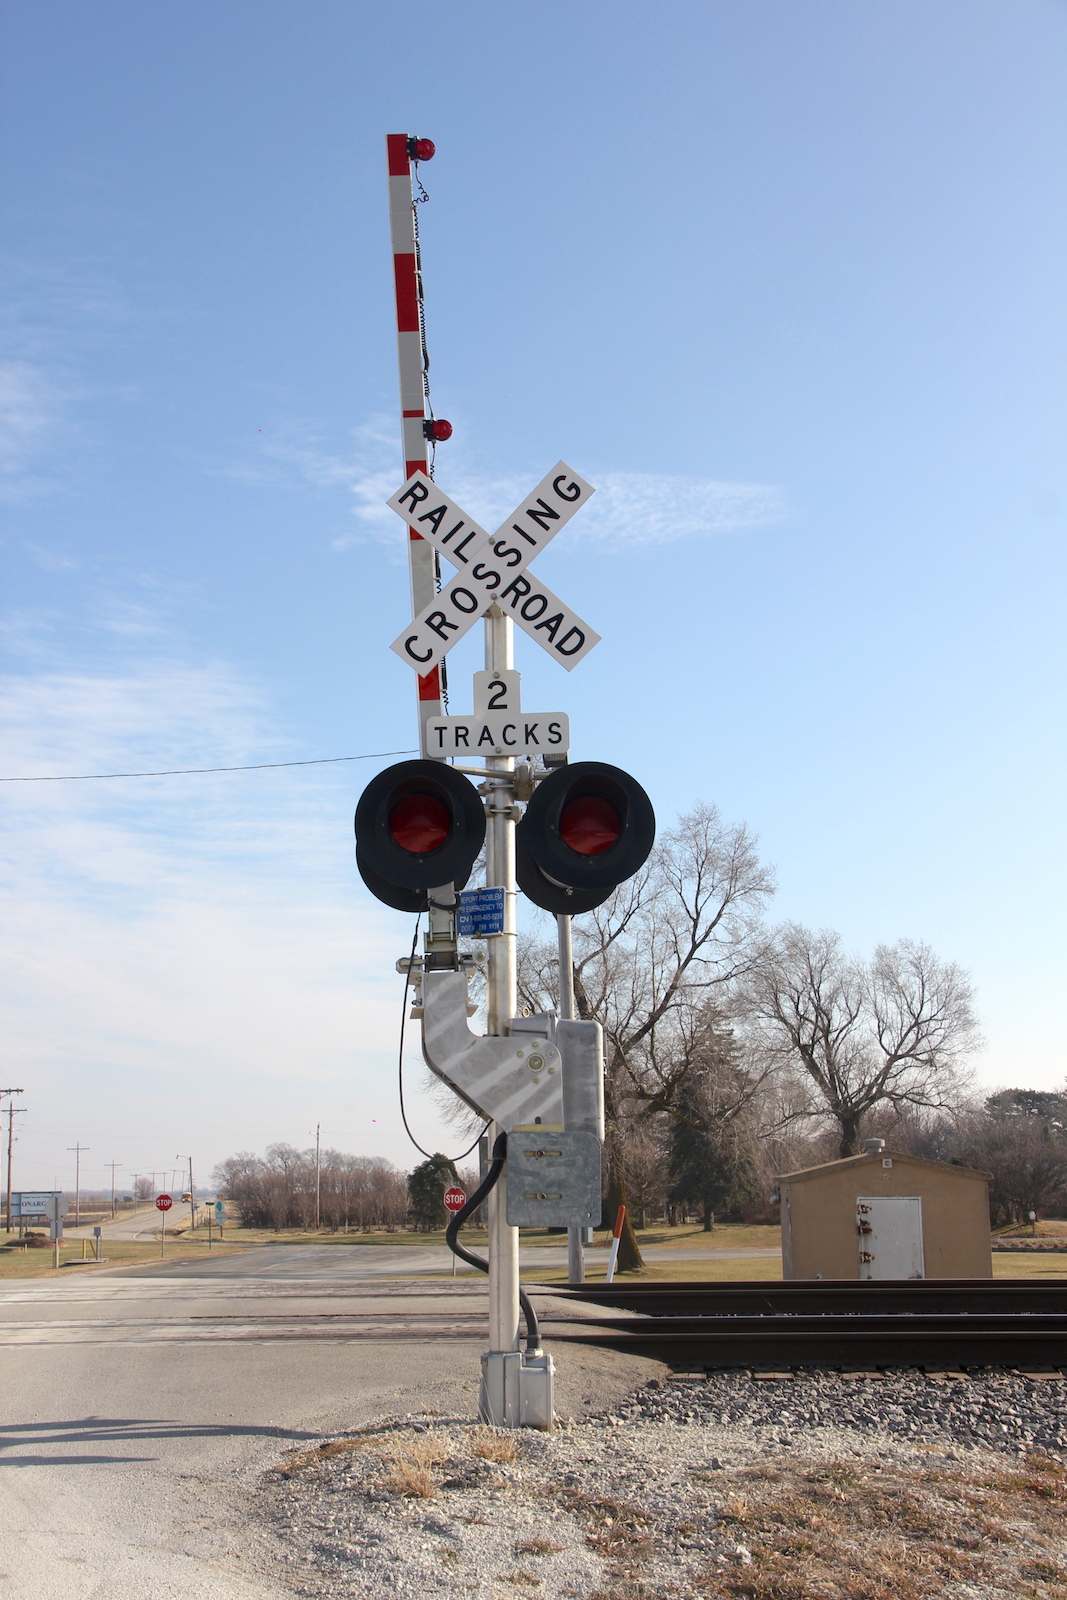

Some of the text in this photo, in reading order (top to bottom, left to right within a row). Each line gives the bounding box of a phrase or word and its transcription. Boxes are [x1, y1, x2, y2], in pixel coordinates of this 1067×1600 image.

[398, 480, 586, 657] RAIL ROAD
[404, 474, 581, 663] CROSSING
[487, 680, 508, 710] 2
[434, 722, 563, 748] TRACKS
[466, 904, 495, 912] EMERGENCY
[446, 1195, 464, 1204] STOP
